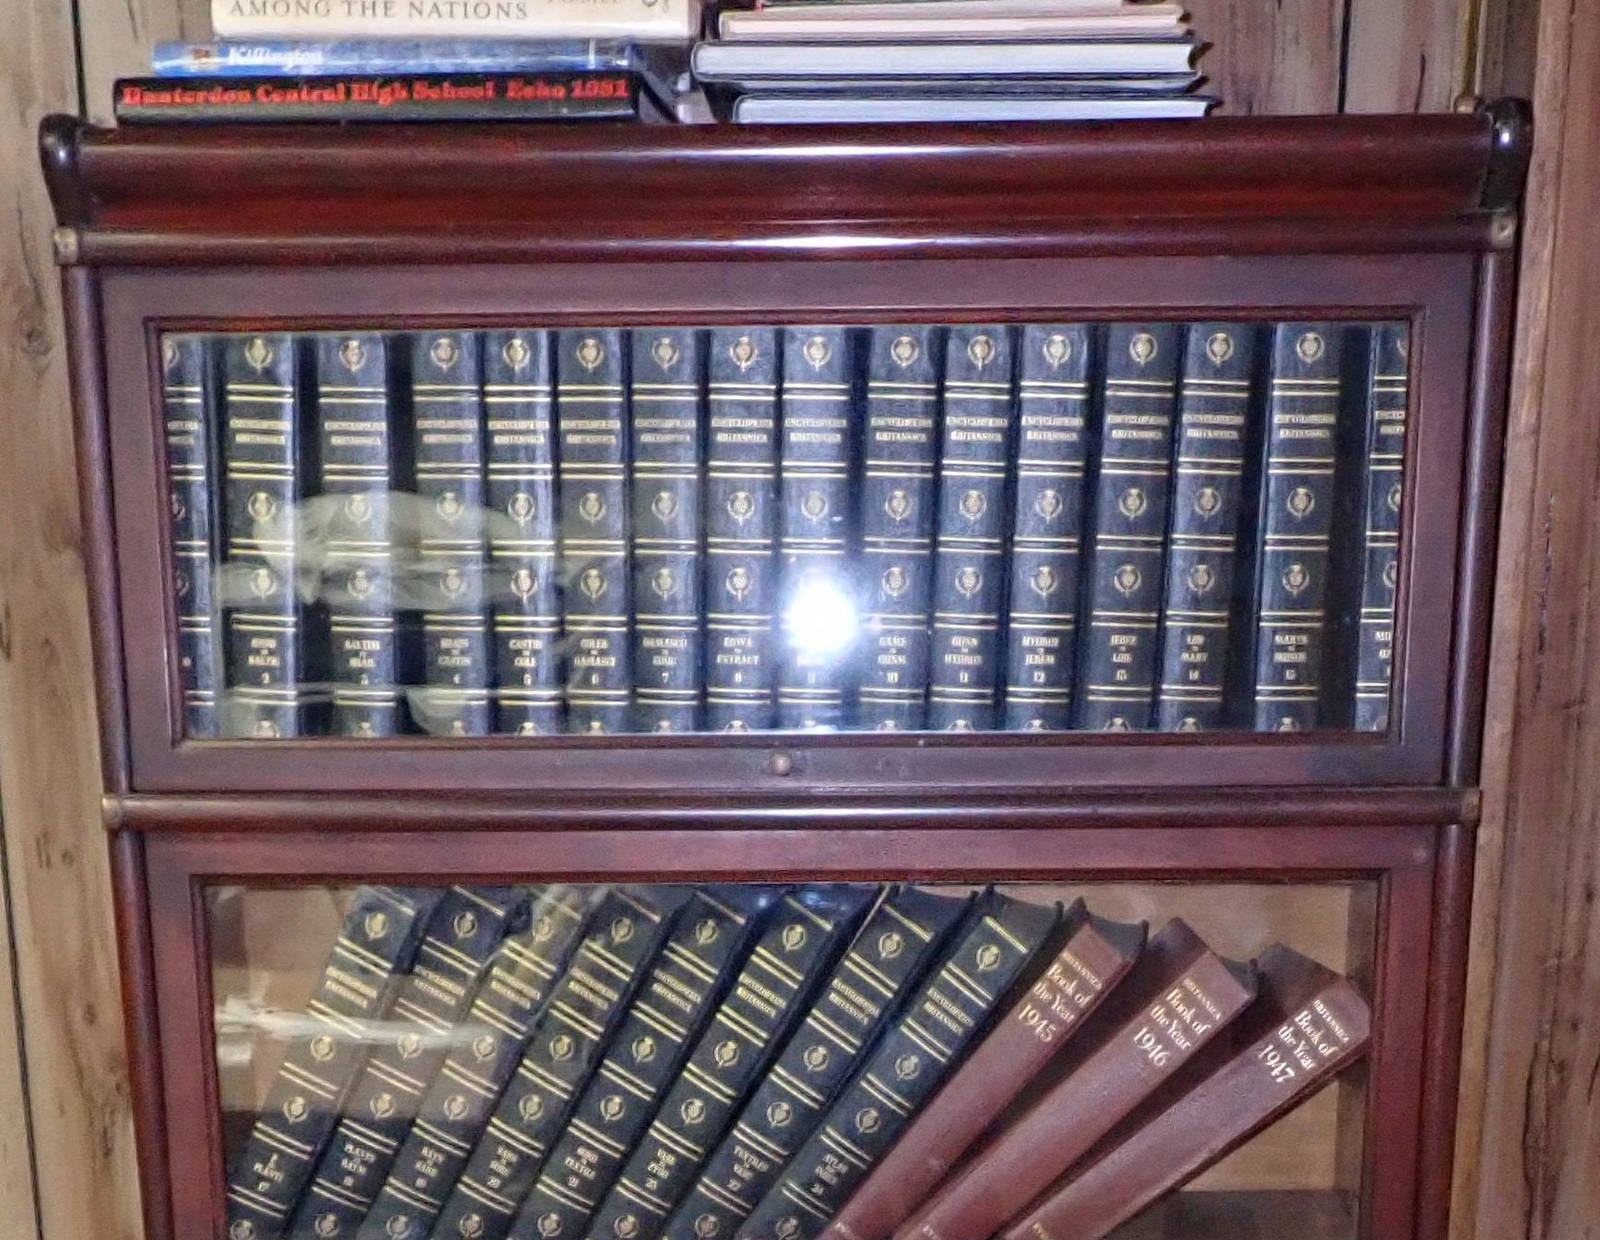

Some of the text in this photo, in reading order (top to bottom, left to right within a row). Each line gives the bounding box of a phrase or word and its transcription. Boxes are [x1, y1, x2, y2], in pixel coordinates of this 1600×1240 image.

[229, 0, 529, 20] AMONG THE NATIONS
[228, 46, 324, 71] Killington
[255, 82, 346, 104] Central
[351, 80, 410, 106] High
[412, 79, 497, 99] School
[661, 672, 670, 683] 7
[1033, 671, 1047, 683] 12
[1033, 982, 1076, 1024] the Year
[1047, 964, 1090, 1008] Book of
[1018, 1005, 1056, 1042] 1945
[1150, 1005, 1193, 1051] the Year
[1166, 989, 1212, 1034] Book of
[1311, 999, 1351, 1043] BRITANNICA
[1133, 1027, 1170, 1067] 1946
[1277, 1025, 1318, 1070] the Year
[1294, 1010, 1341, 1058] Book of
[1257, 1045, 1296, 1083] 1947
